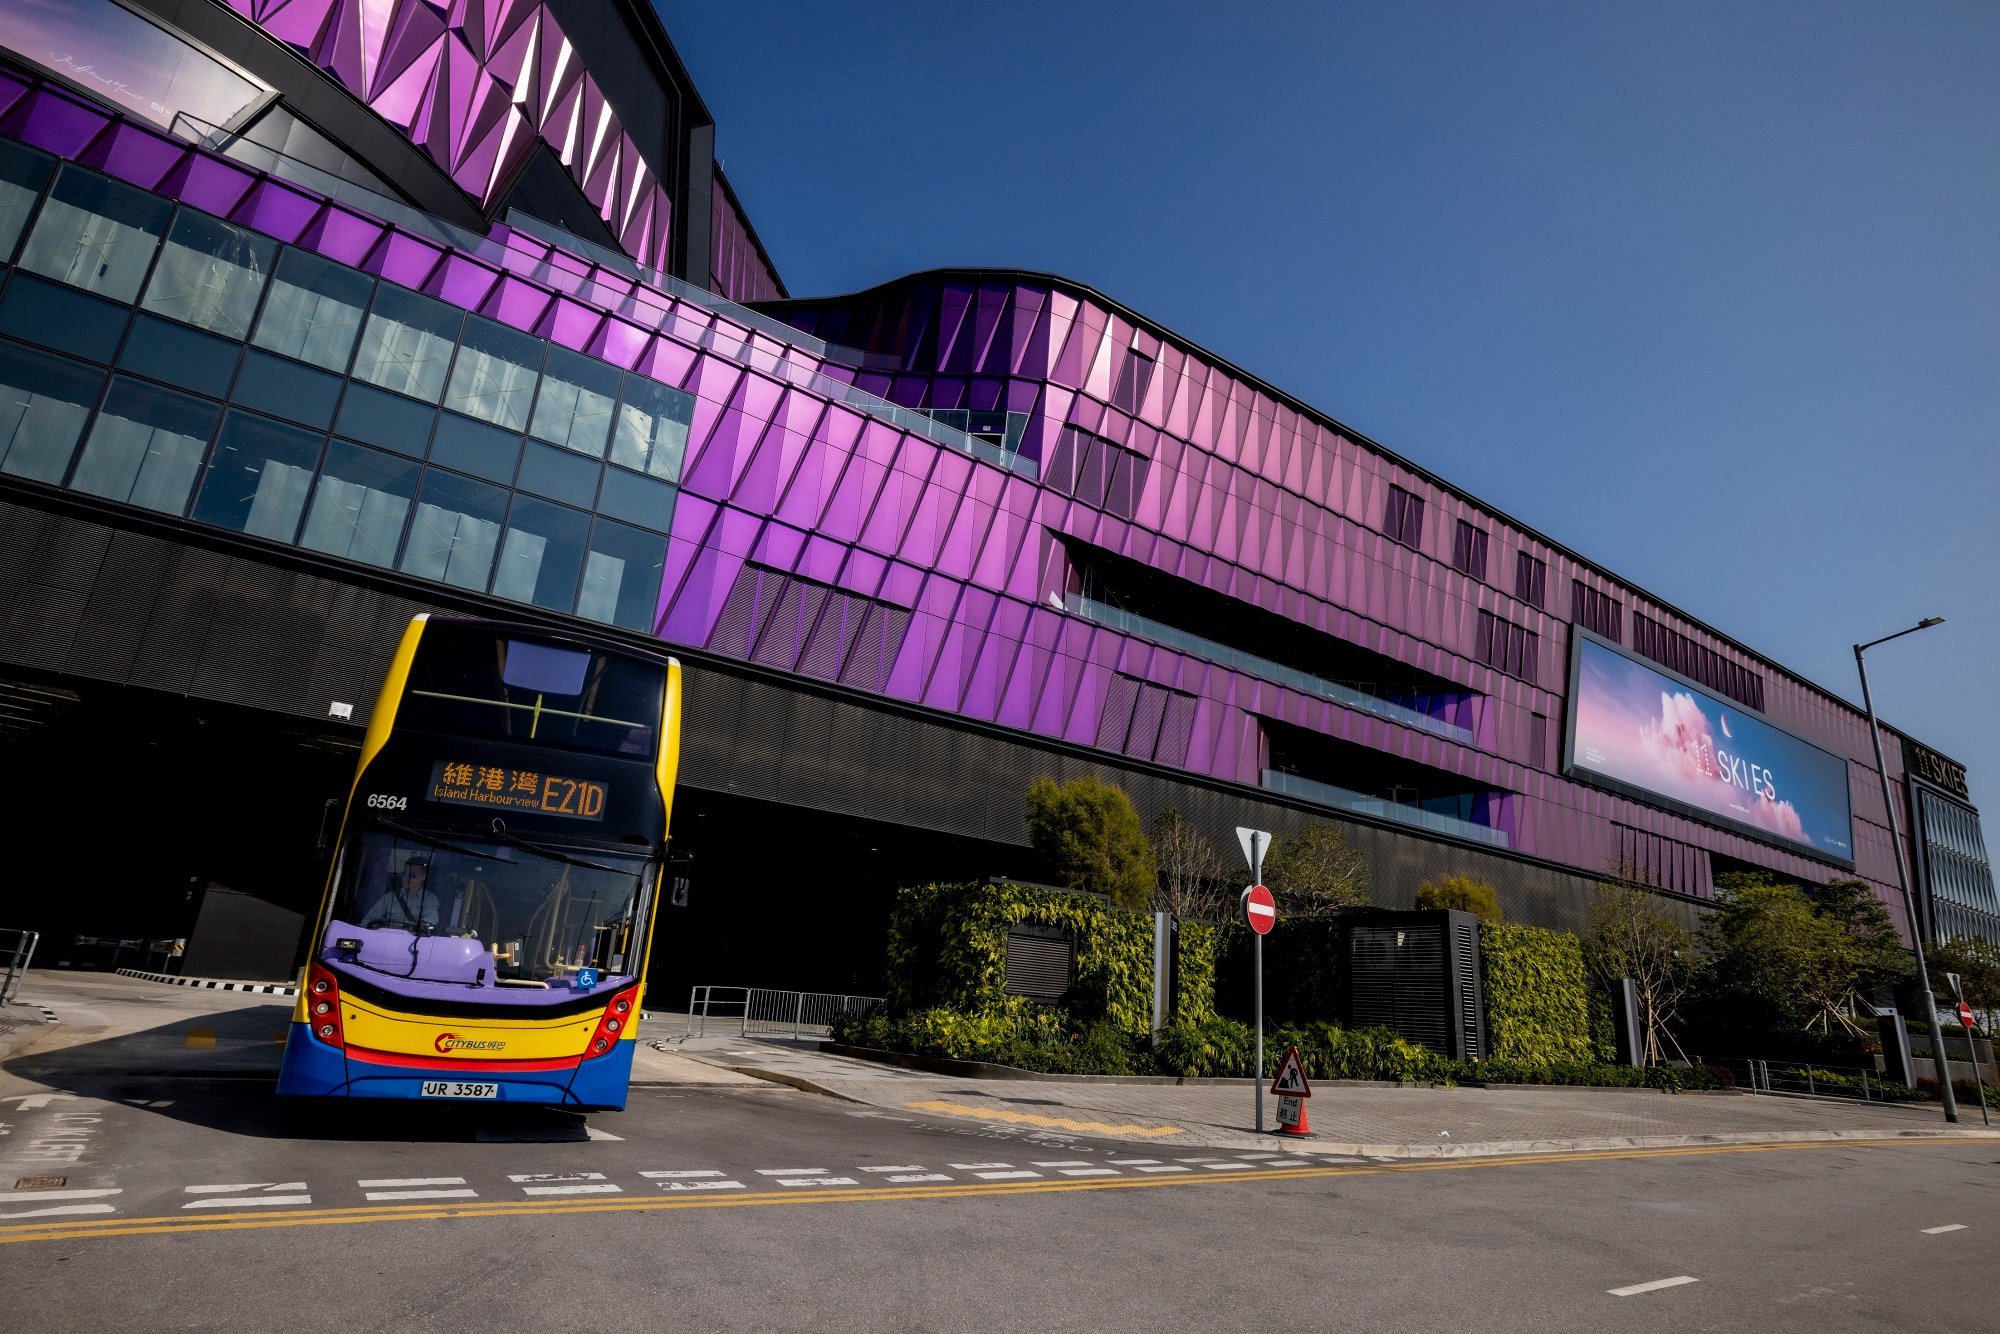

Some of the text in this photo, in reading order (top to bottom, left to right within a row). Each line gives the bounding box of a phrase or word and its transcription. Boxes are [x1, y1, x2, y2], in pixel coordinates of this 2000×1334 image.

[442, 762, 539, 795] 維港灣
[1691, 739, 1776, 801] 11 SKIES
[1930, 754, 1969, 797] SKIES
[433, 784, 468, 800] Island
[540, 776, 604, 817] E21D
[367, 793, 408, 811] 6564
[445, 1039, 487, 1049] CITYBUS
[426, 1082, 494, 1097] UR 3587
[1283, 1096, 1298, 1108] End
